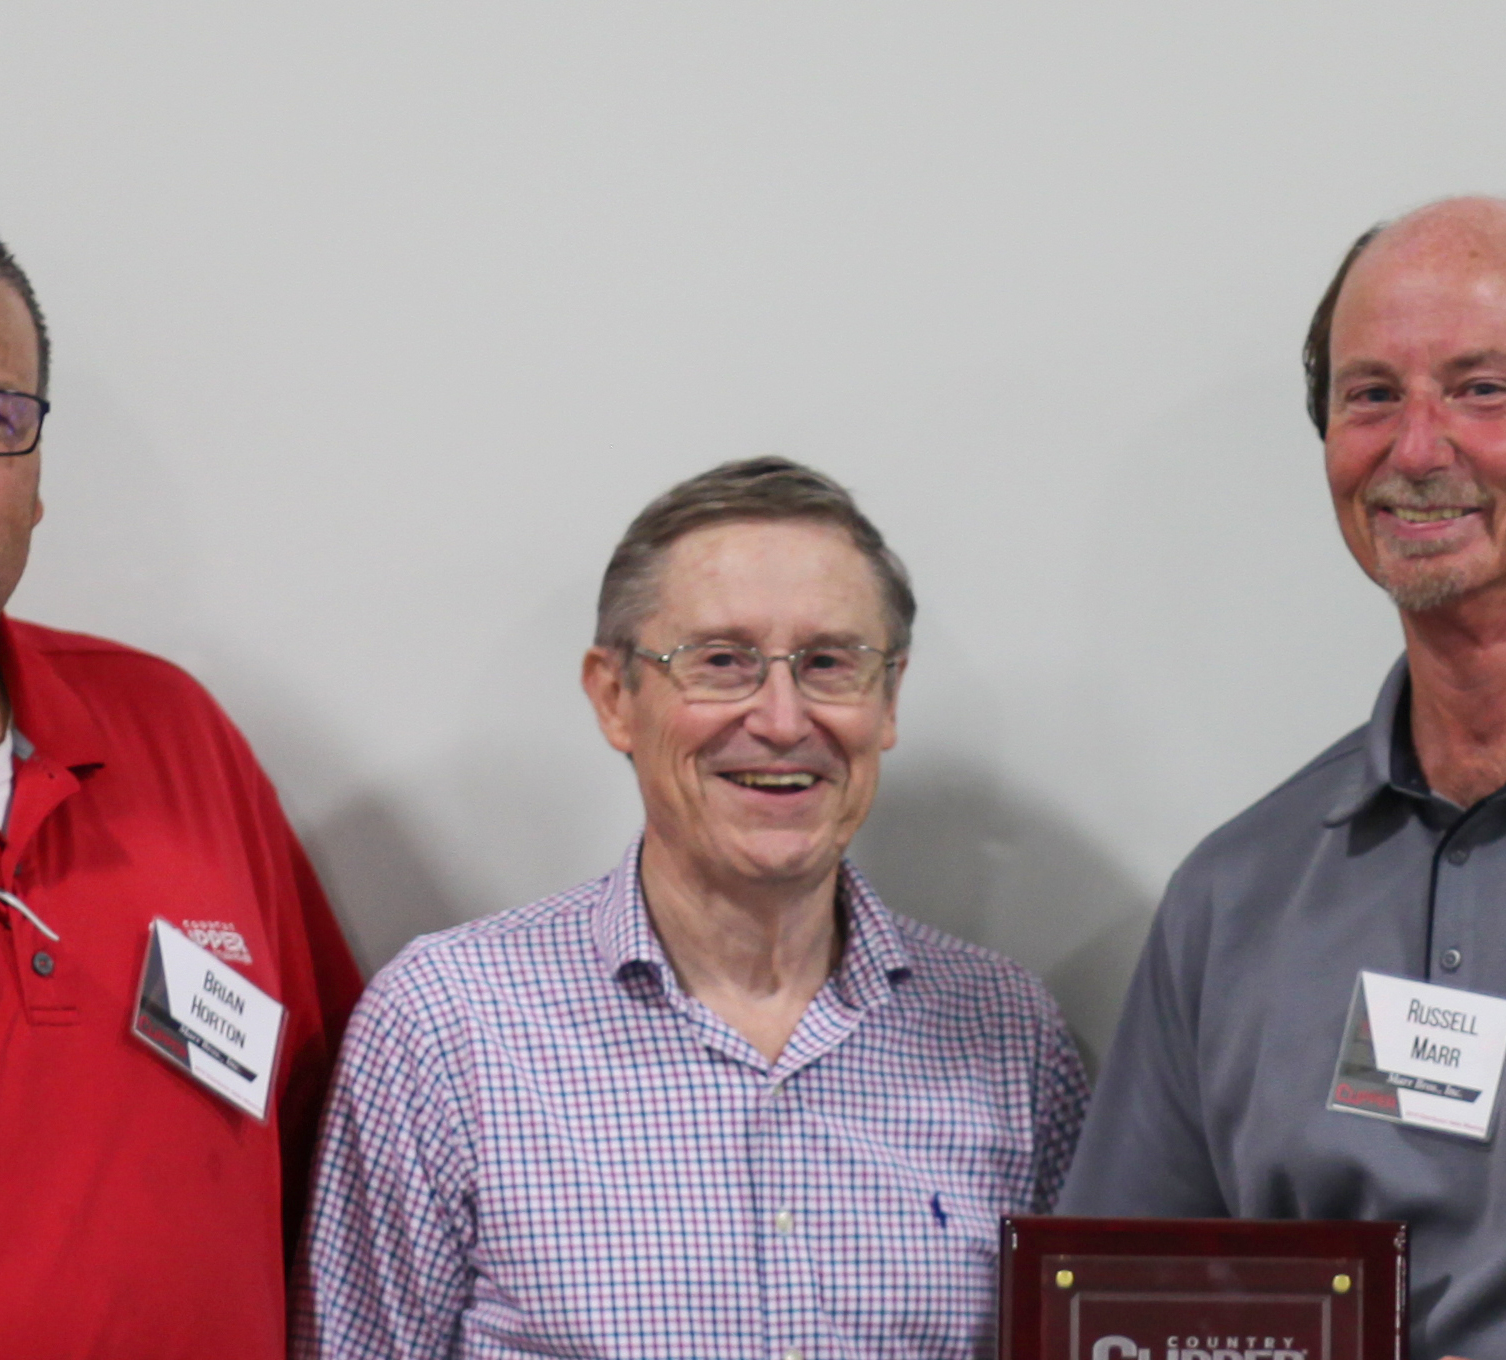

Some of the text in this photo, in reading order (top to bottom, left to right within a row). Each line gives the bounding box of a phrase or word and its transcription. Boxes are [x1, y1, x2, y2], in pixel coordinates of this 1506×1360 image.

[203, 970, 245, 1015] BRIAN
[190, 995, 247, 1048] HORTON
[1407, 999, 1478, 1035] RUSSELL
[1411, 1036, 1462, 1068] MARR
[1166, 1335, 1294, 1348] COUNTRY
